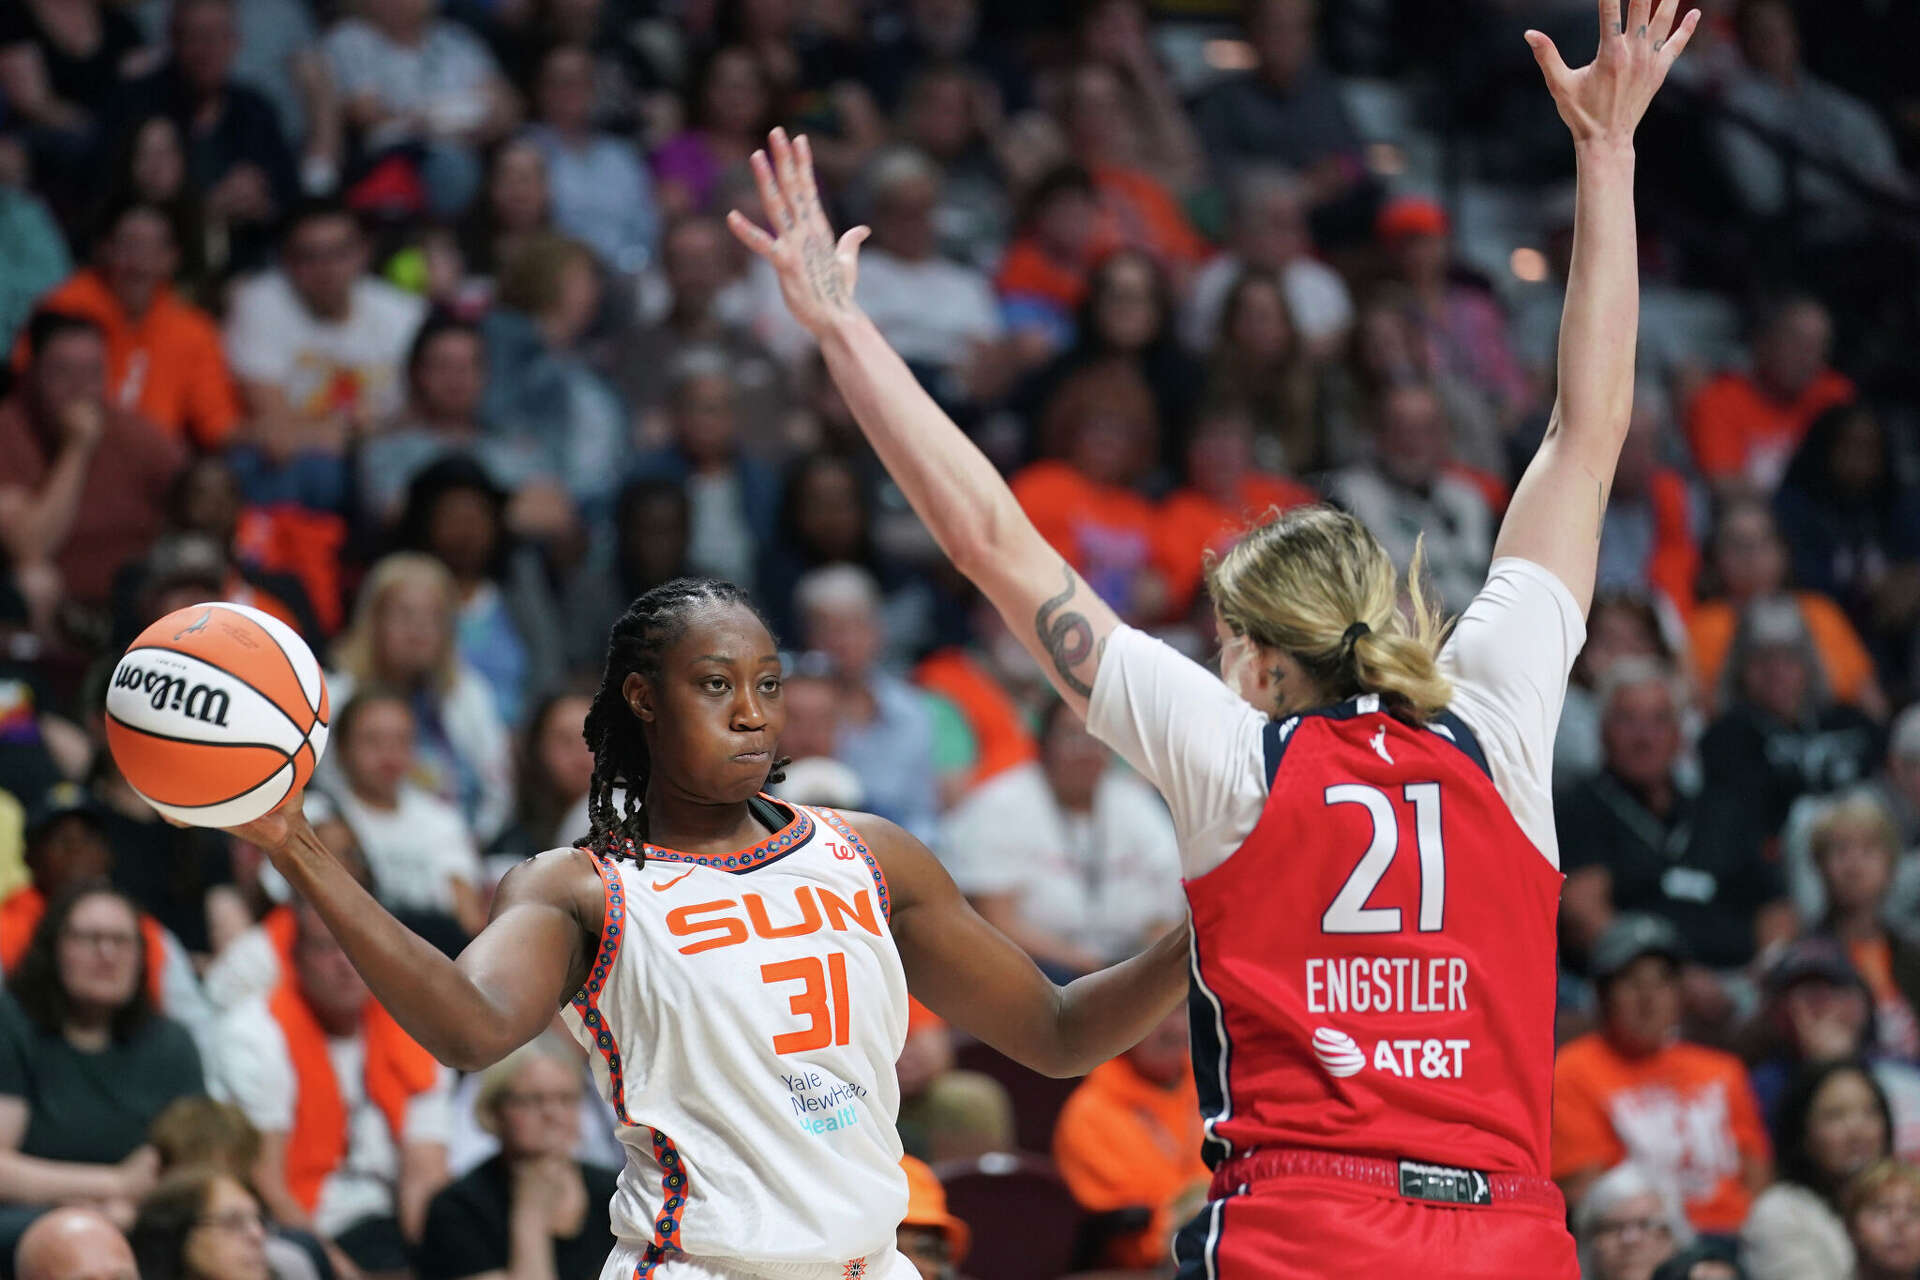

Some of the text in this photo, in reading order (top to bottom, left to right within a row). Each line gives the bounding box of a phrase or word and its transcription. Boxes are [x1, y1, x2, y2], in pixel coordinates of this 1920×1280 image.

[115, 663, 231, 728] Wilson
[1321, 782, 1446, 934] 21
[666, 885, 883, 955] SUN
[760, 952, 849, 1055] 31
[1306, 957, 1467, 1013] ENGSTLER
[781, 1072, 822, 1092] Yale
[1374, 1039, 1470, 1079] AT&T
